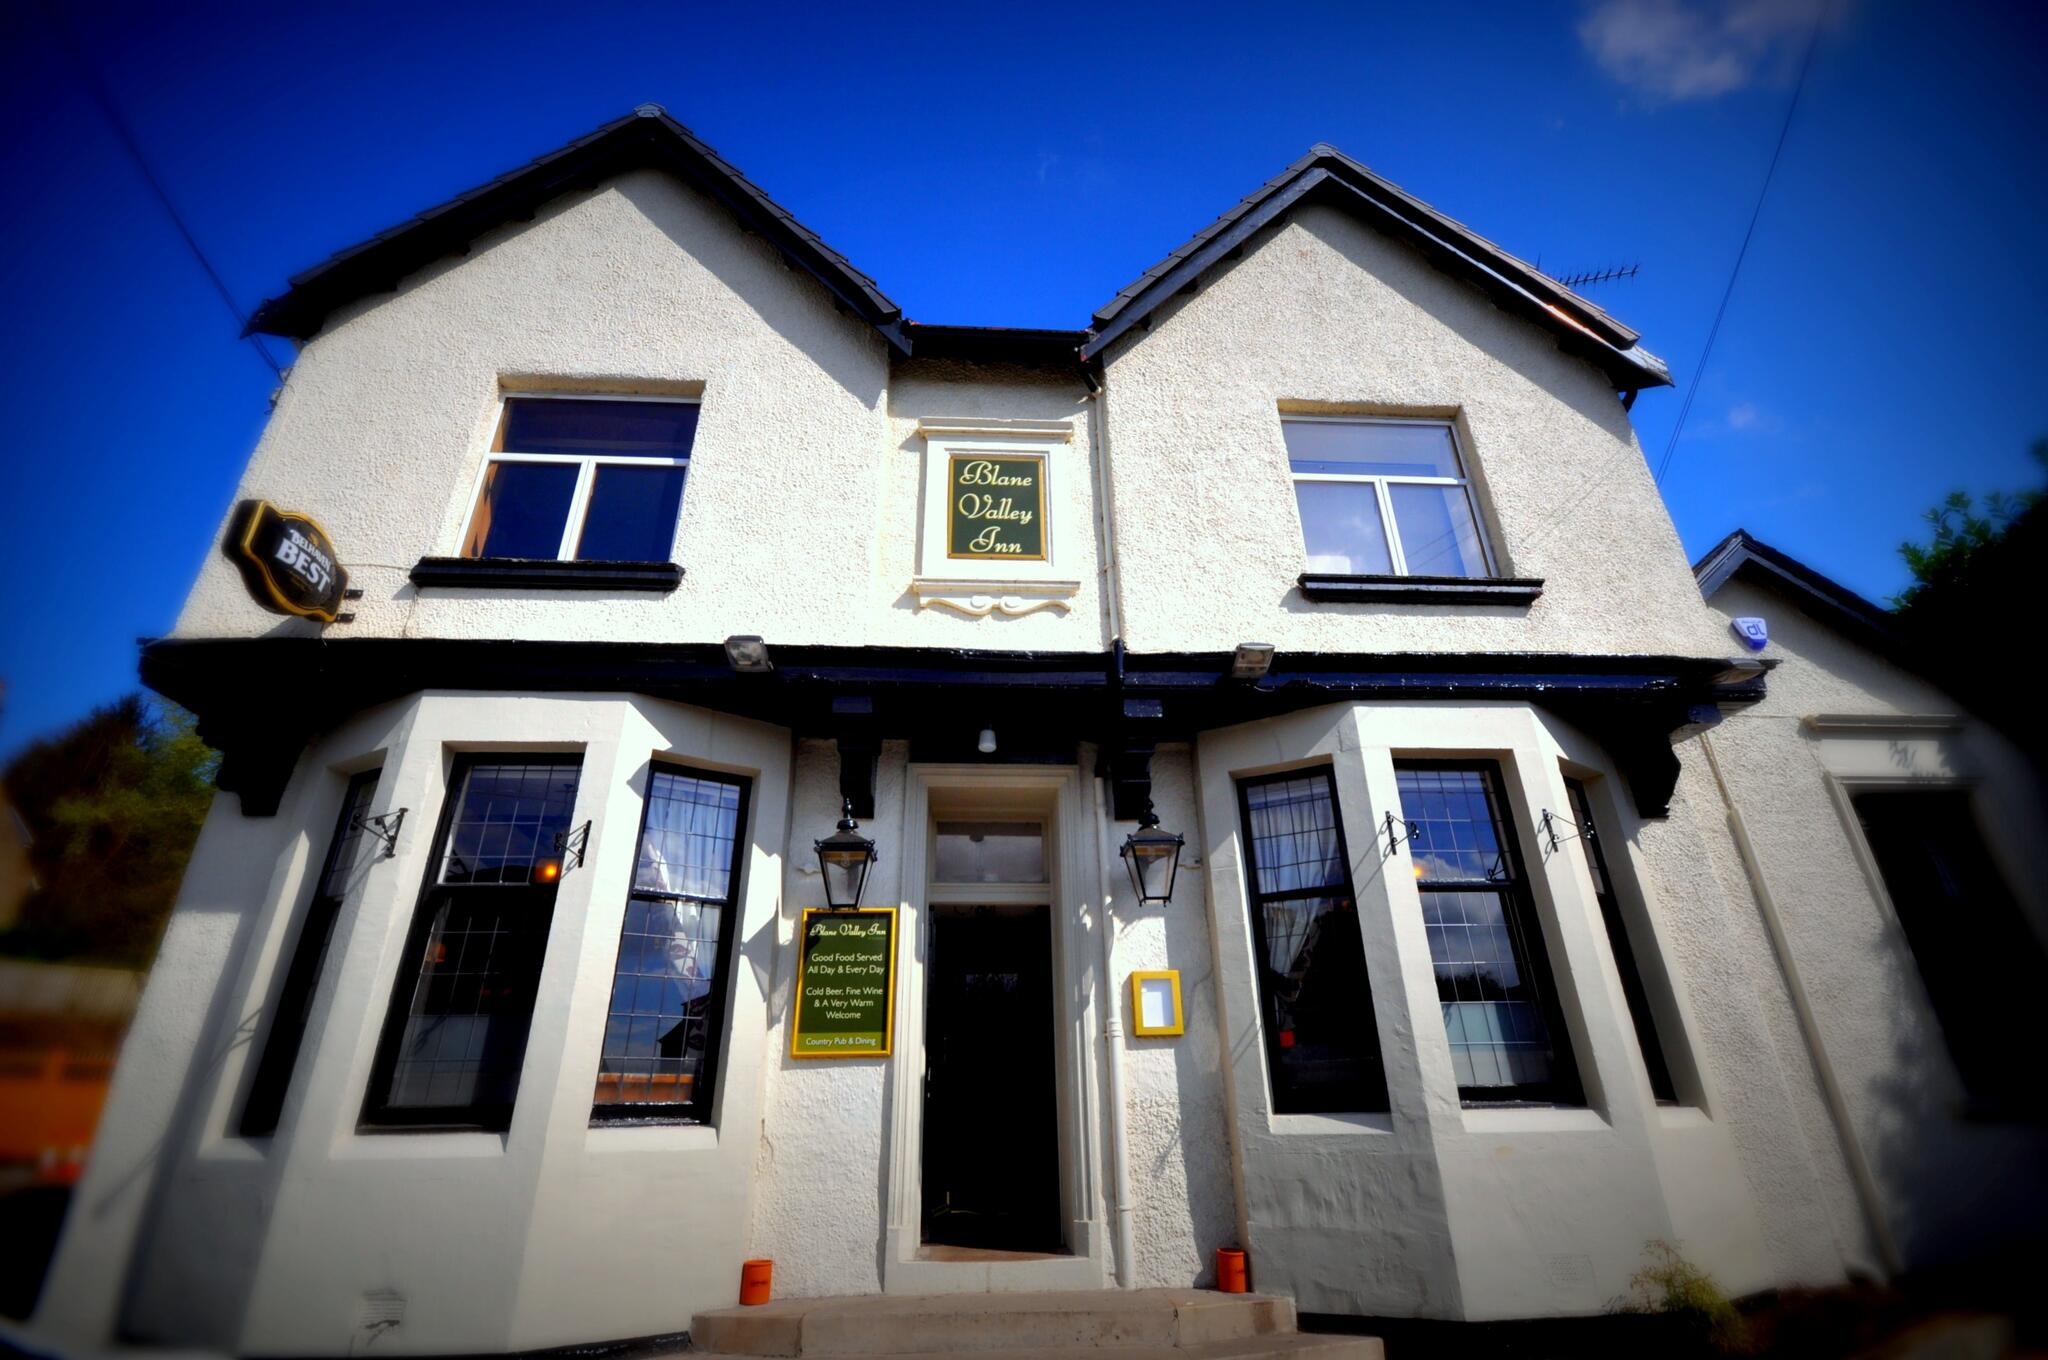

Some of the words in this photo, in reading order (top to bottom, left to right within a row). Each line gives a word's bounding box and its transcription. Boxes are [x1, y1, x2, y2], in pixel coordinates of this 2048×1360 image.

[958, 460, 1033, 487] Blane
[958, 493, 1033, 525] Valley
[968, 526, 1022, 553] Inn
[290, 529, 331, 572] BELHAVEN
[275, 538, 331, 592] BEST
[809, 923, 837, 936] Blane
[839, 923, 866, 938] Valley
[867, 922, 887, 936] Inn
[811, 953, 833, 962] Good
[835, 953, 855, 962] Food
[856, 952, 883, 961] Served
[807, 965, 819, 974] All
[820, 965, 836, 976] Day
[837, 965, 844, 974] &
[846, 965, 867, 976] Every
[869, 965, 885, 976] Day
[806, 987, 824, 996] Cold
[825, 987, 844, 996] Beer,
[845, 986, 861, 995] Fine
[862, 986, 884, 995] Wine
[814, 1000, 820, 1008] &
[822, 1000, 829, 1008] A
[831, 1000, 848, 1010] Very
[850, 999, 874, 1007] Warm
[825, 1010, 862, 1019] Welcome
[806, 1037, 833, 1047] Country
[834, 1036, 846, 1045] Pub
[848, 1036, 854, 1045] &
[855, 1036, 877, 1046] Dining
